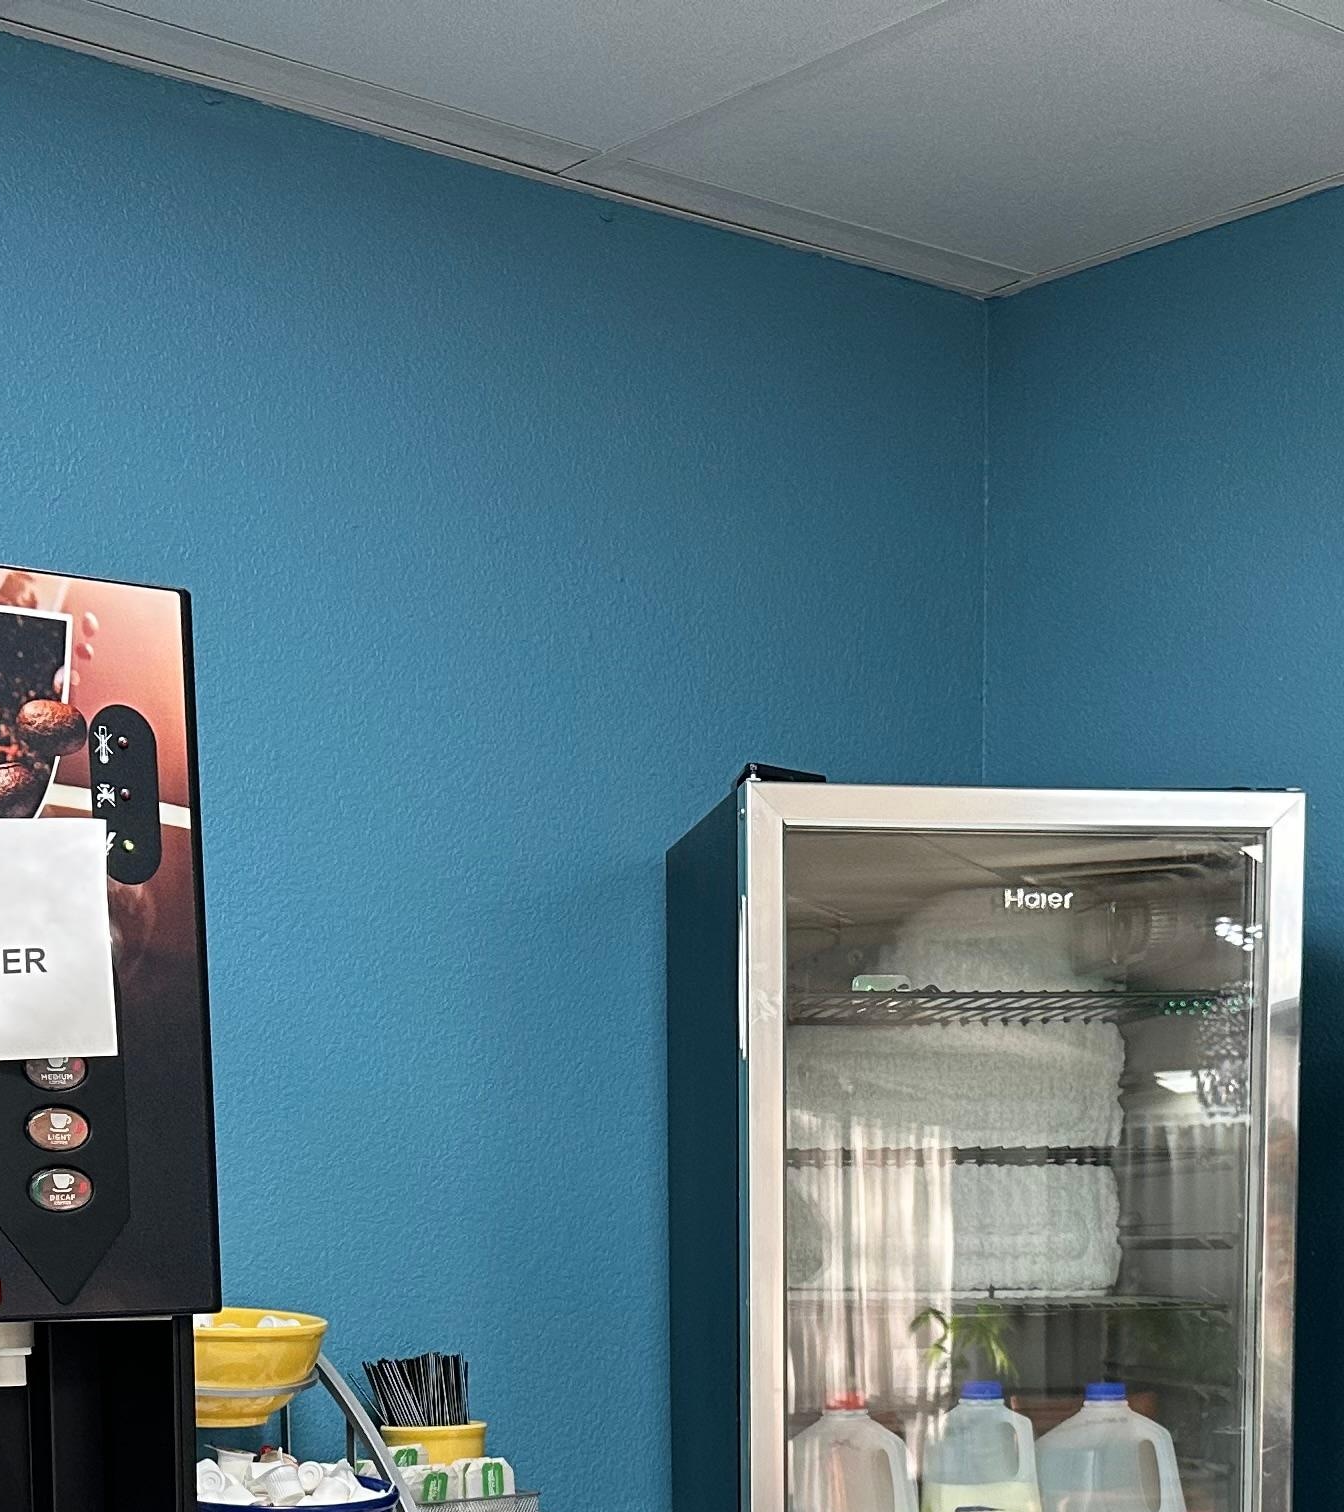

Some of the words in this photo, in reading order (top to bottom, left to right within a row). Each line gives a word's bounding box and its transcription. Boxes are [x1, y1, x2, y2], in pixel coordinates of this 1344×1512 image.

[1004, 888, 1074, 909] Haier
[47, 1133, 72, 1141] LIGHT
[49, 1193, 76, 1201] DECAF
